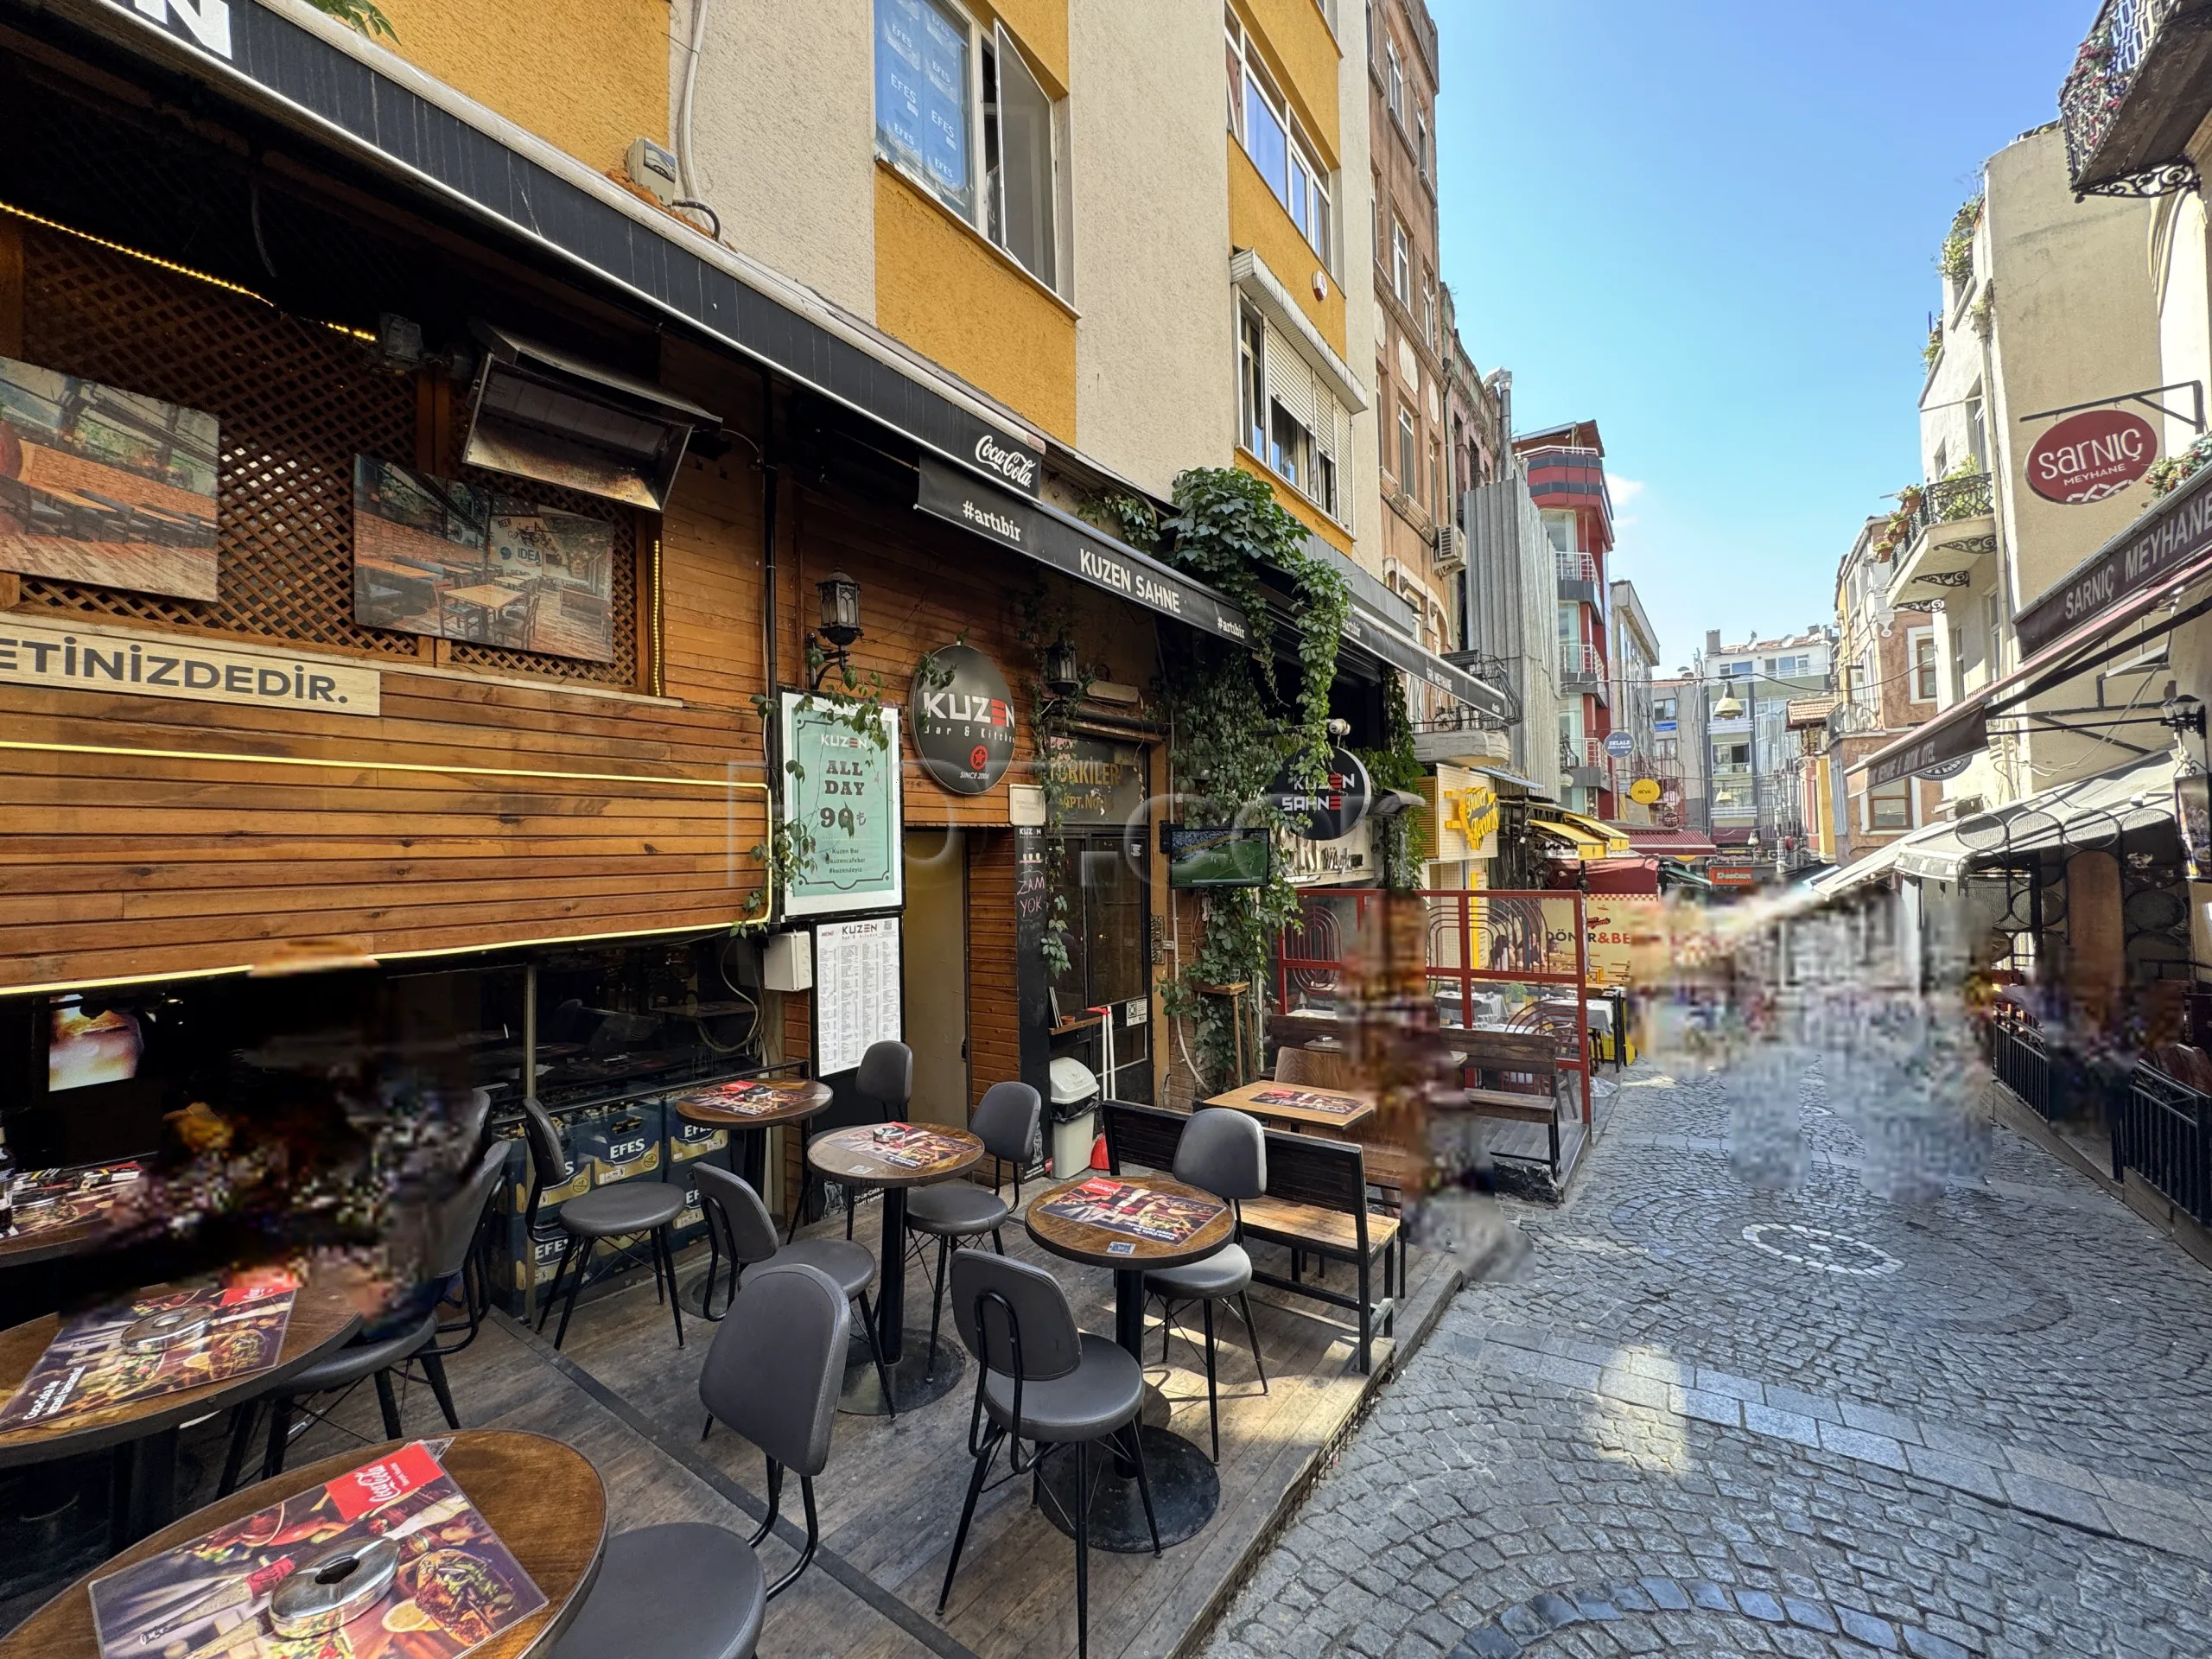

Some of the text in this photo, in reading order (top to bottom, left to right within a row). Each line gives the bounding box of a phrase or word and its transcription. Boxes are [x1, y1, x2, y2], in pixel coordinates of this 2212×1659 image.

[892, 22, 912, 48] EFES
[932, 60, 950, 84] EFES
[891, 73, 917, 105] EFES
[894, 123, 915, 146] EFES
[931, 110, 955, 139] EFES
[935, 157, 954, 178] EFES
[975, 435, 1037, 489] Coca-Cola
[2063, 463, 2126, 486] MEYHANE
[1079, 547, 1181, 614] KUZEN SAHNE
[2065, 563, 2115, 620] SARNIÇ
[923, 691, 1016, 728] KUZEN
[821, 734, 868, 749] KUZEN
[964, 726, 970, 737] &
[825, 760, 863, 777] ALL
[959, 771, 977, 779] SINCE
[824, 779, 865, 796] DAY
[1281, 795, 1342, 811] SAHNE
[1016, 875, 1046, 895] ZAM
[1020, 896, 1043, 918] YOK
[842, 923, 878, 935] KUZEN
[684, 1125, 713, 1138] EF
[609, 1137, 645, 1160] EFES
[685, 1189, 700, 1204] EF
[534, 1239, 569, 1261] EFE
